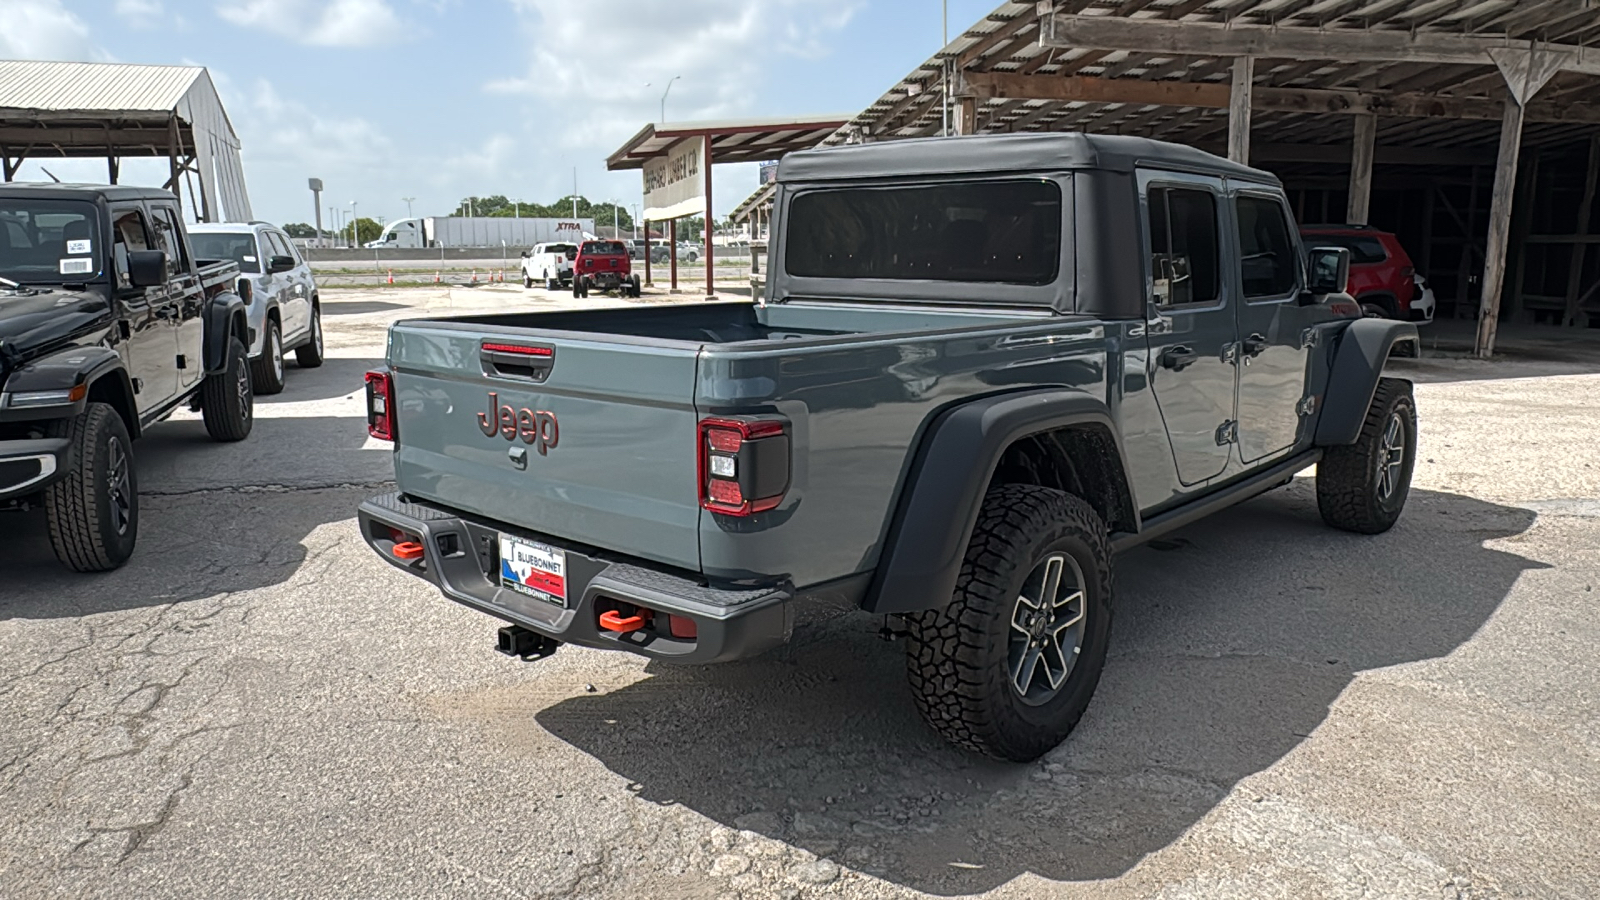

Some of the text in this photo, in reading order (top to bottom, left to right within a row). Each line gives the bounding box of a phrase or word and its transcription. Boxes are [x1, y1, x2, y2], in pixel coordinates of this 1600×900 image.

[668, 154, 687, 185] LUMBER
[556, 222, 581, 231] XTRA
[477, 392, 559, 457] Jeep
[518, 551, 561, 573] BLUEBONNET
[513, 583, 551, 602] BLUEBONNET
